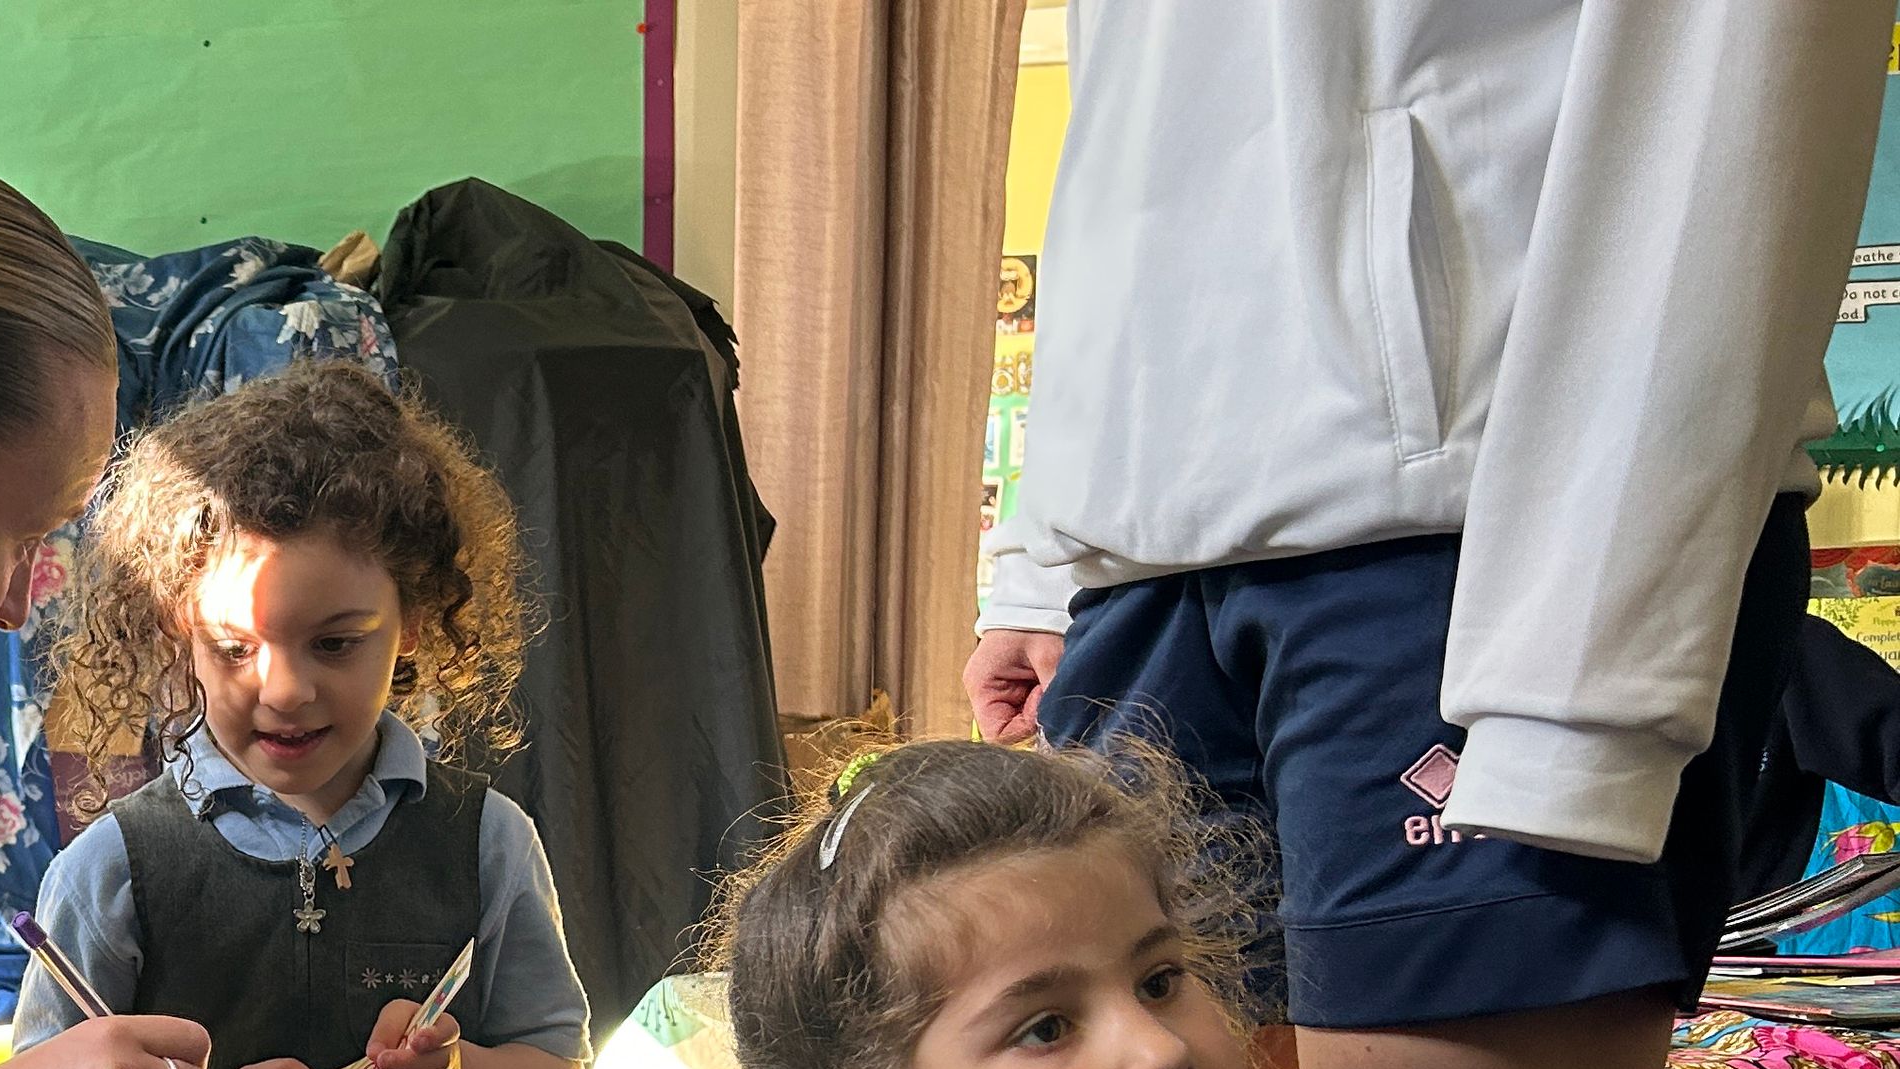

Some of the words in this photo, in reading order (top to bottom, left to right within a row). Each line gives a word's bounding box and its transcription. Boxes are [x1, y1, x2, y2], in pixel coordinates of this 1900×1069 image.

[1855, 250, 1894, 263] eathe
[1863, 289, 1887, 300] not
[1837, 308, 1862, 320] od.
